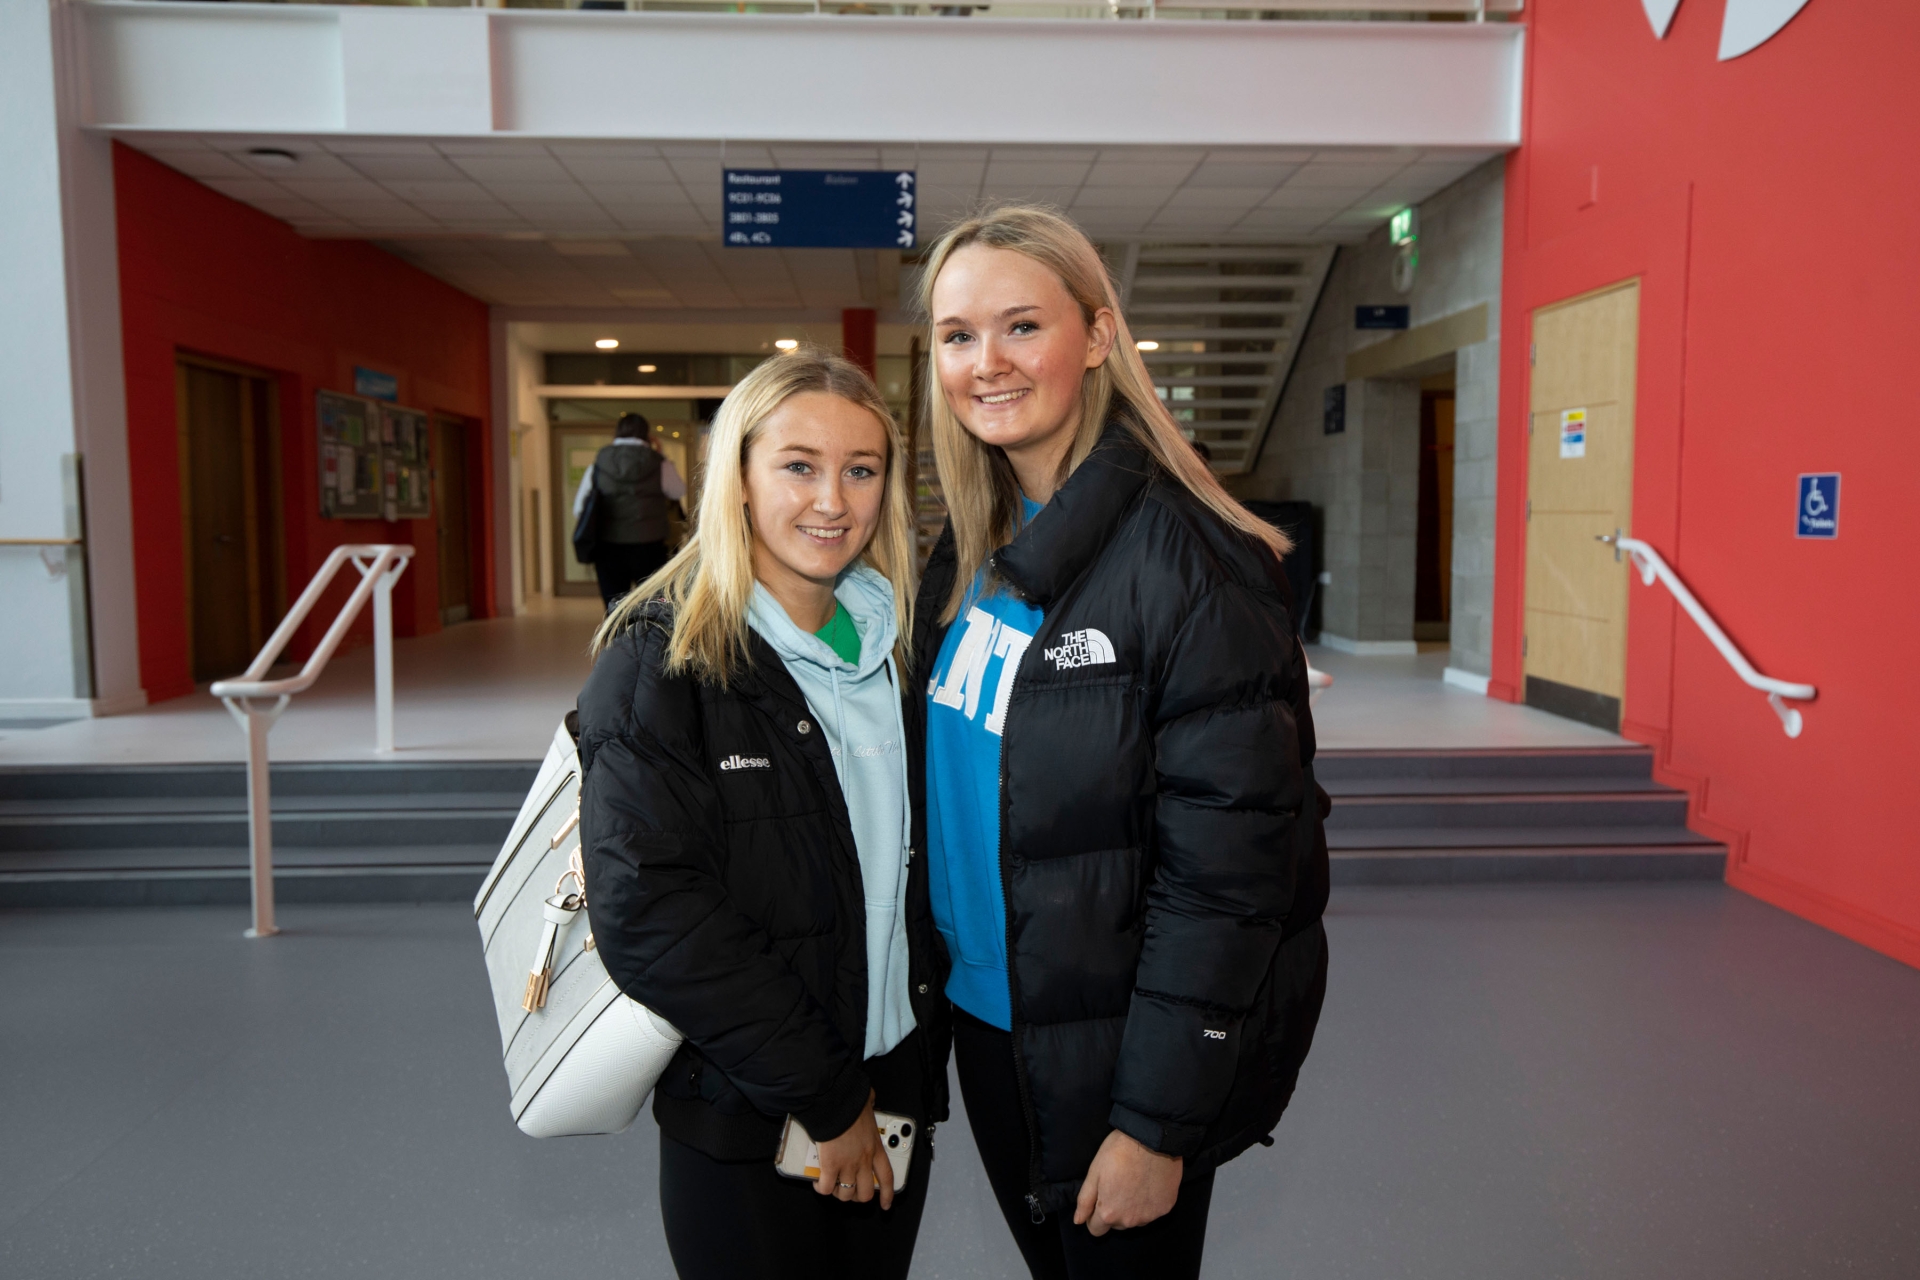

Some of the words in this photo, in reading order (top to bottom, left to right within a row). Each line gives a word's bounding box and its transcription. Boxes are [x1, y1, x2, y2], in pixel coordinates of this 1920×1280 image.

[728, 172, 781, 185] Restaurant
[1061, 629, 1087, 645] THE
[1044, 641, 1089, 661] NORTH
[1056, 653, 1091, 671] FACE
[720, 754, 771, 770] ellesse
[1203, 1029, 1226, 1039] 700
